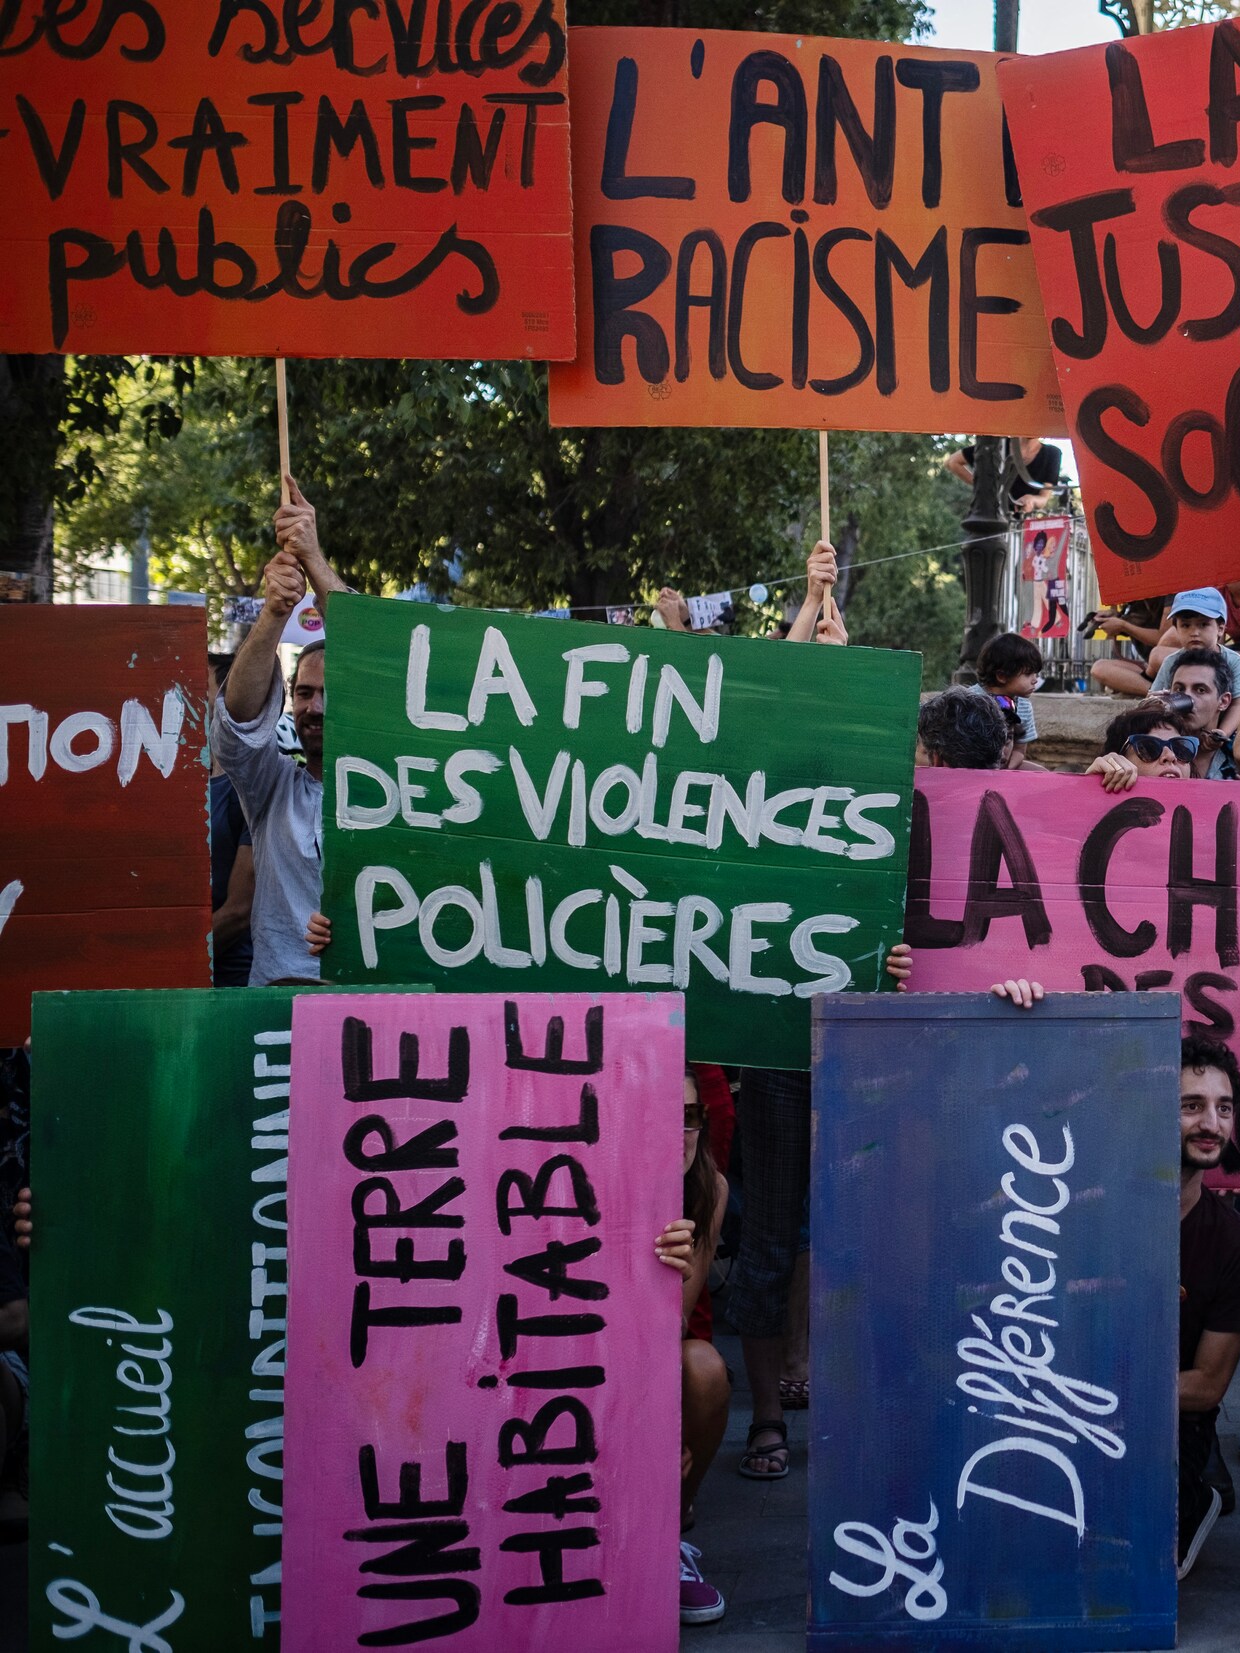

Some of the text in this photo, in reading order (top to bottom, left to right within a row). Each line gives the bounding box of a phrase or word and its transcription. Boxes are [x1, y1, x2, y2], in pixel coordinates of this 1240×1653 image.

[16, 91, 566, 200] VRAIMENT
[49, 200, 500, 350] publics
[406, 623, 724, 748] LA FIN
[335, 745, 900, 860] DES VIOLENCES
[903, 788, 1053, 950] LA
[355, 857, 860, 998] POLICIÈRES
[341, 1016, 482, 1647] UNE TERRE
[828, 1492, 948, 1621] La
